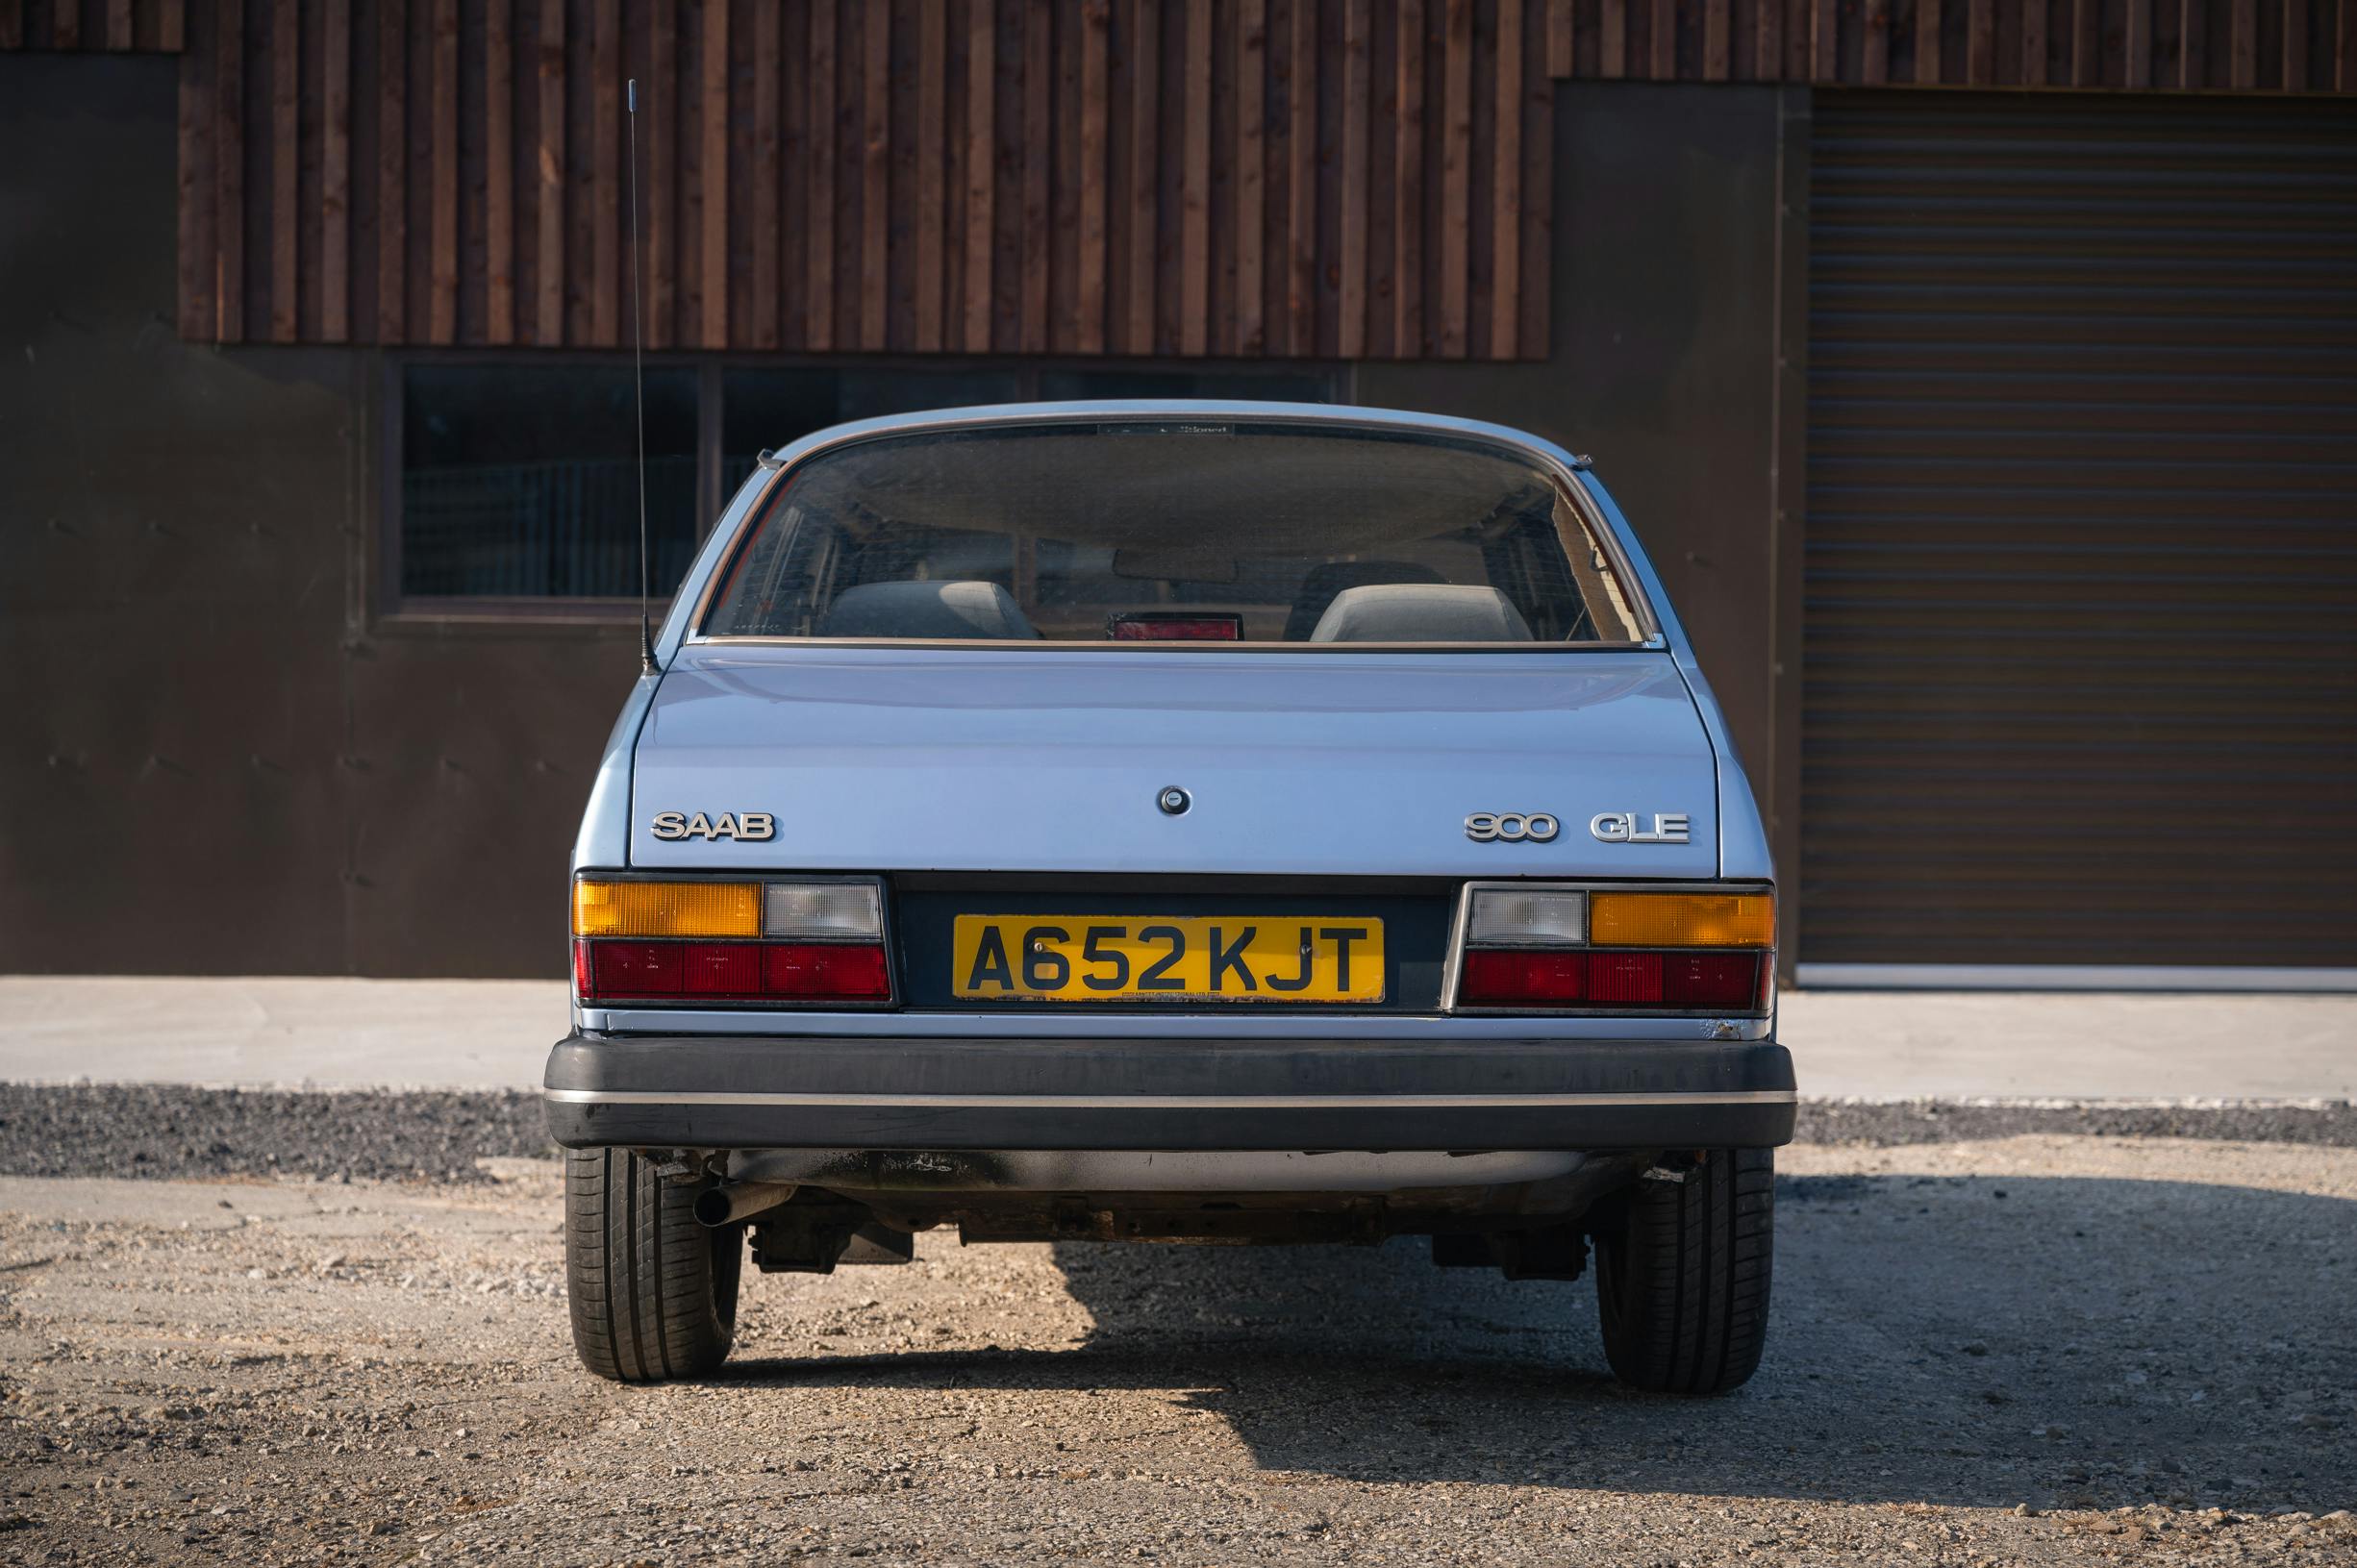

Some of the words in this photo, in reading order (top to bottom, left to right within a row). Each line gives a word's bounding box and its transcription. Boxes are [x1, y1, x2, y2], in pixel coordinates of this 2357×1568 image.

[651, 811, 776, 841] SAAB
[1465, 812, 1560, 842] 900
[1590, 812, 1690, 843] GLE
[967, 926, 1186, 991] A652
[1210, 926, 1367, 992] KJT
